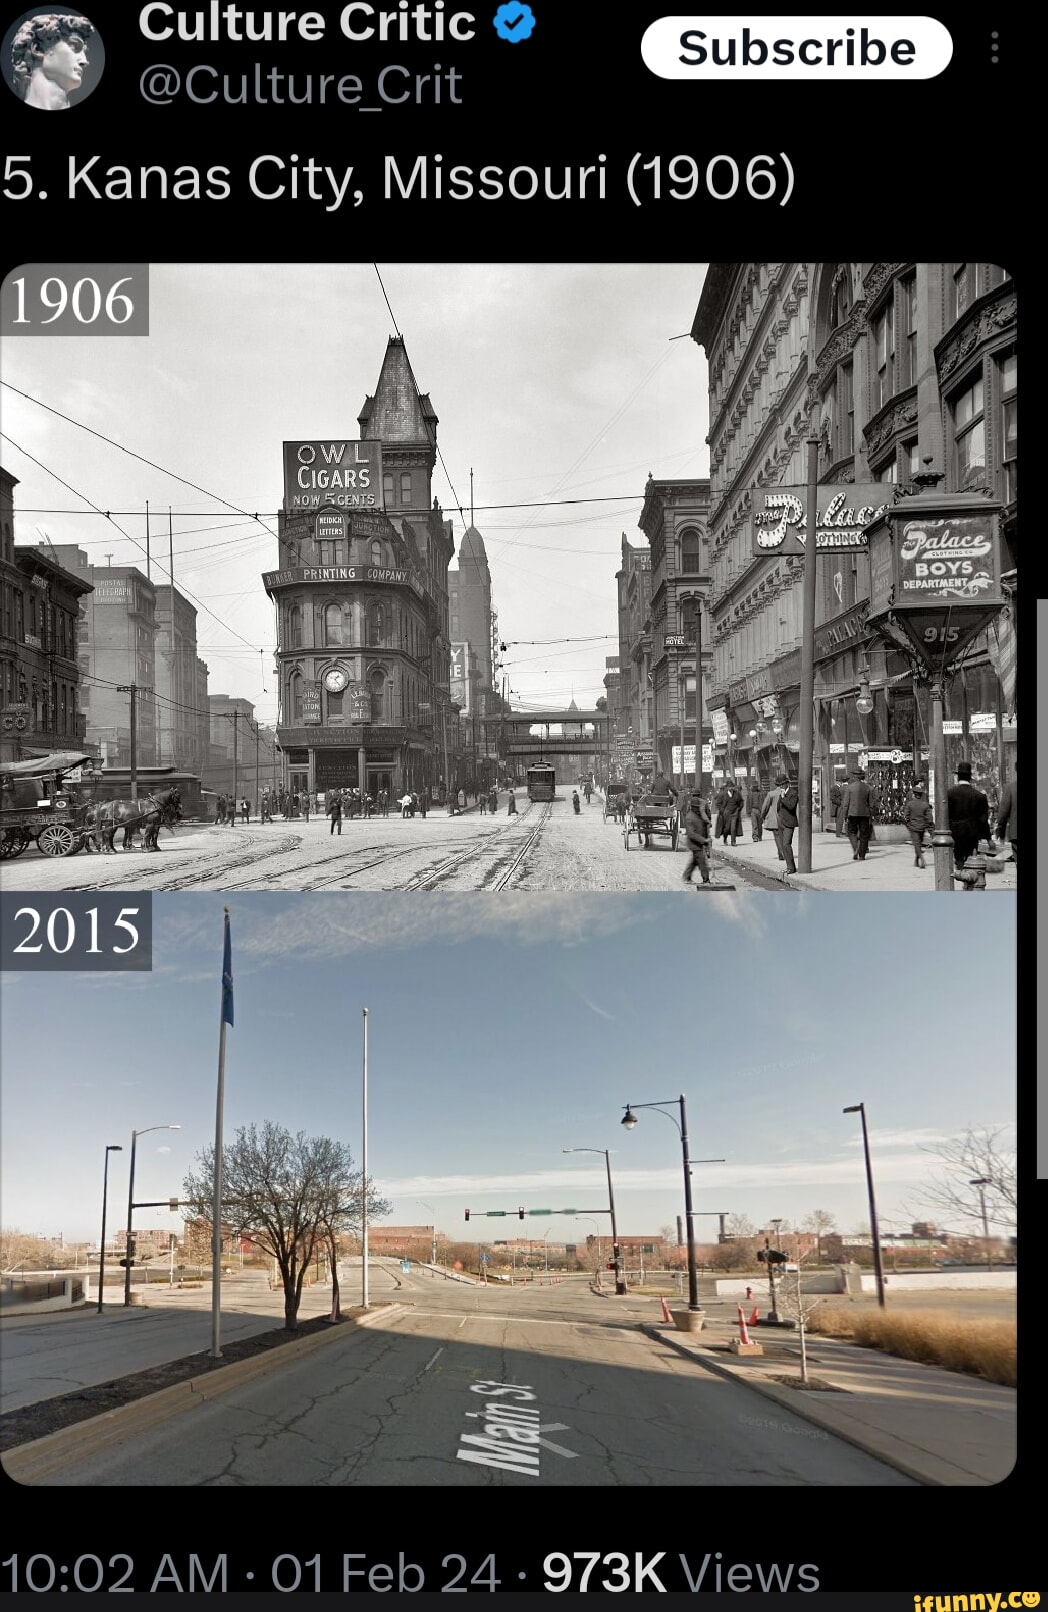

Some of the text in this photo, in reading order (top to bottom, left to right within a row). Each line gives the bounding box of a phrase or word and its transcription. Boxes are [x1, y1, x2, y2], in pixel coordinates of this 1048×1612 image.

[139, 0, 475, 40] Culture Critic
[679, 28, 915, 65] Subscribe
[140, 63, 462, 111] @Culture_Crit
[3, 152, 794, 211] 5. Kanas City, Missouri (1906)
[298, 444, 369, 464] OWL
[298, 465, 370, 489] CIGARS
[294, 493, 375, 506] NOW 5 CENTS
[320, 528, 343, 536] LETTERS
[901, 529, 991, 560] Palace
[303, 568, 356, 580] PRINTING
[915, 560, 973, 577] BOYS
[95, 587, 131, 596] TELEGRAPH
[903, 578, 968, 590] DEPARTMENT
[924, 626, 960, 642] 915
[2, 1552, 819, 1592] 10:02 AM 01 Feb 24 973K Views
